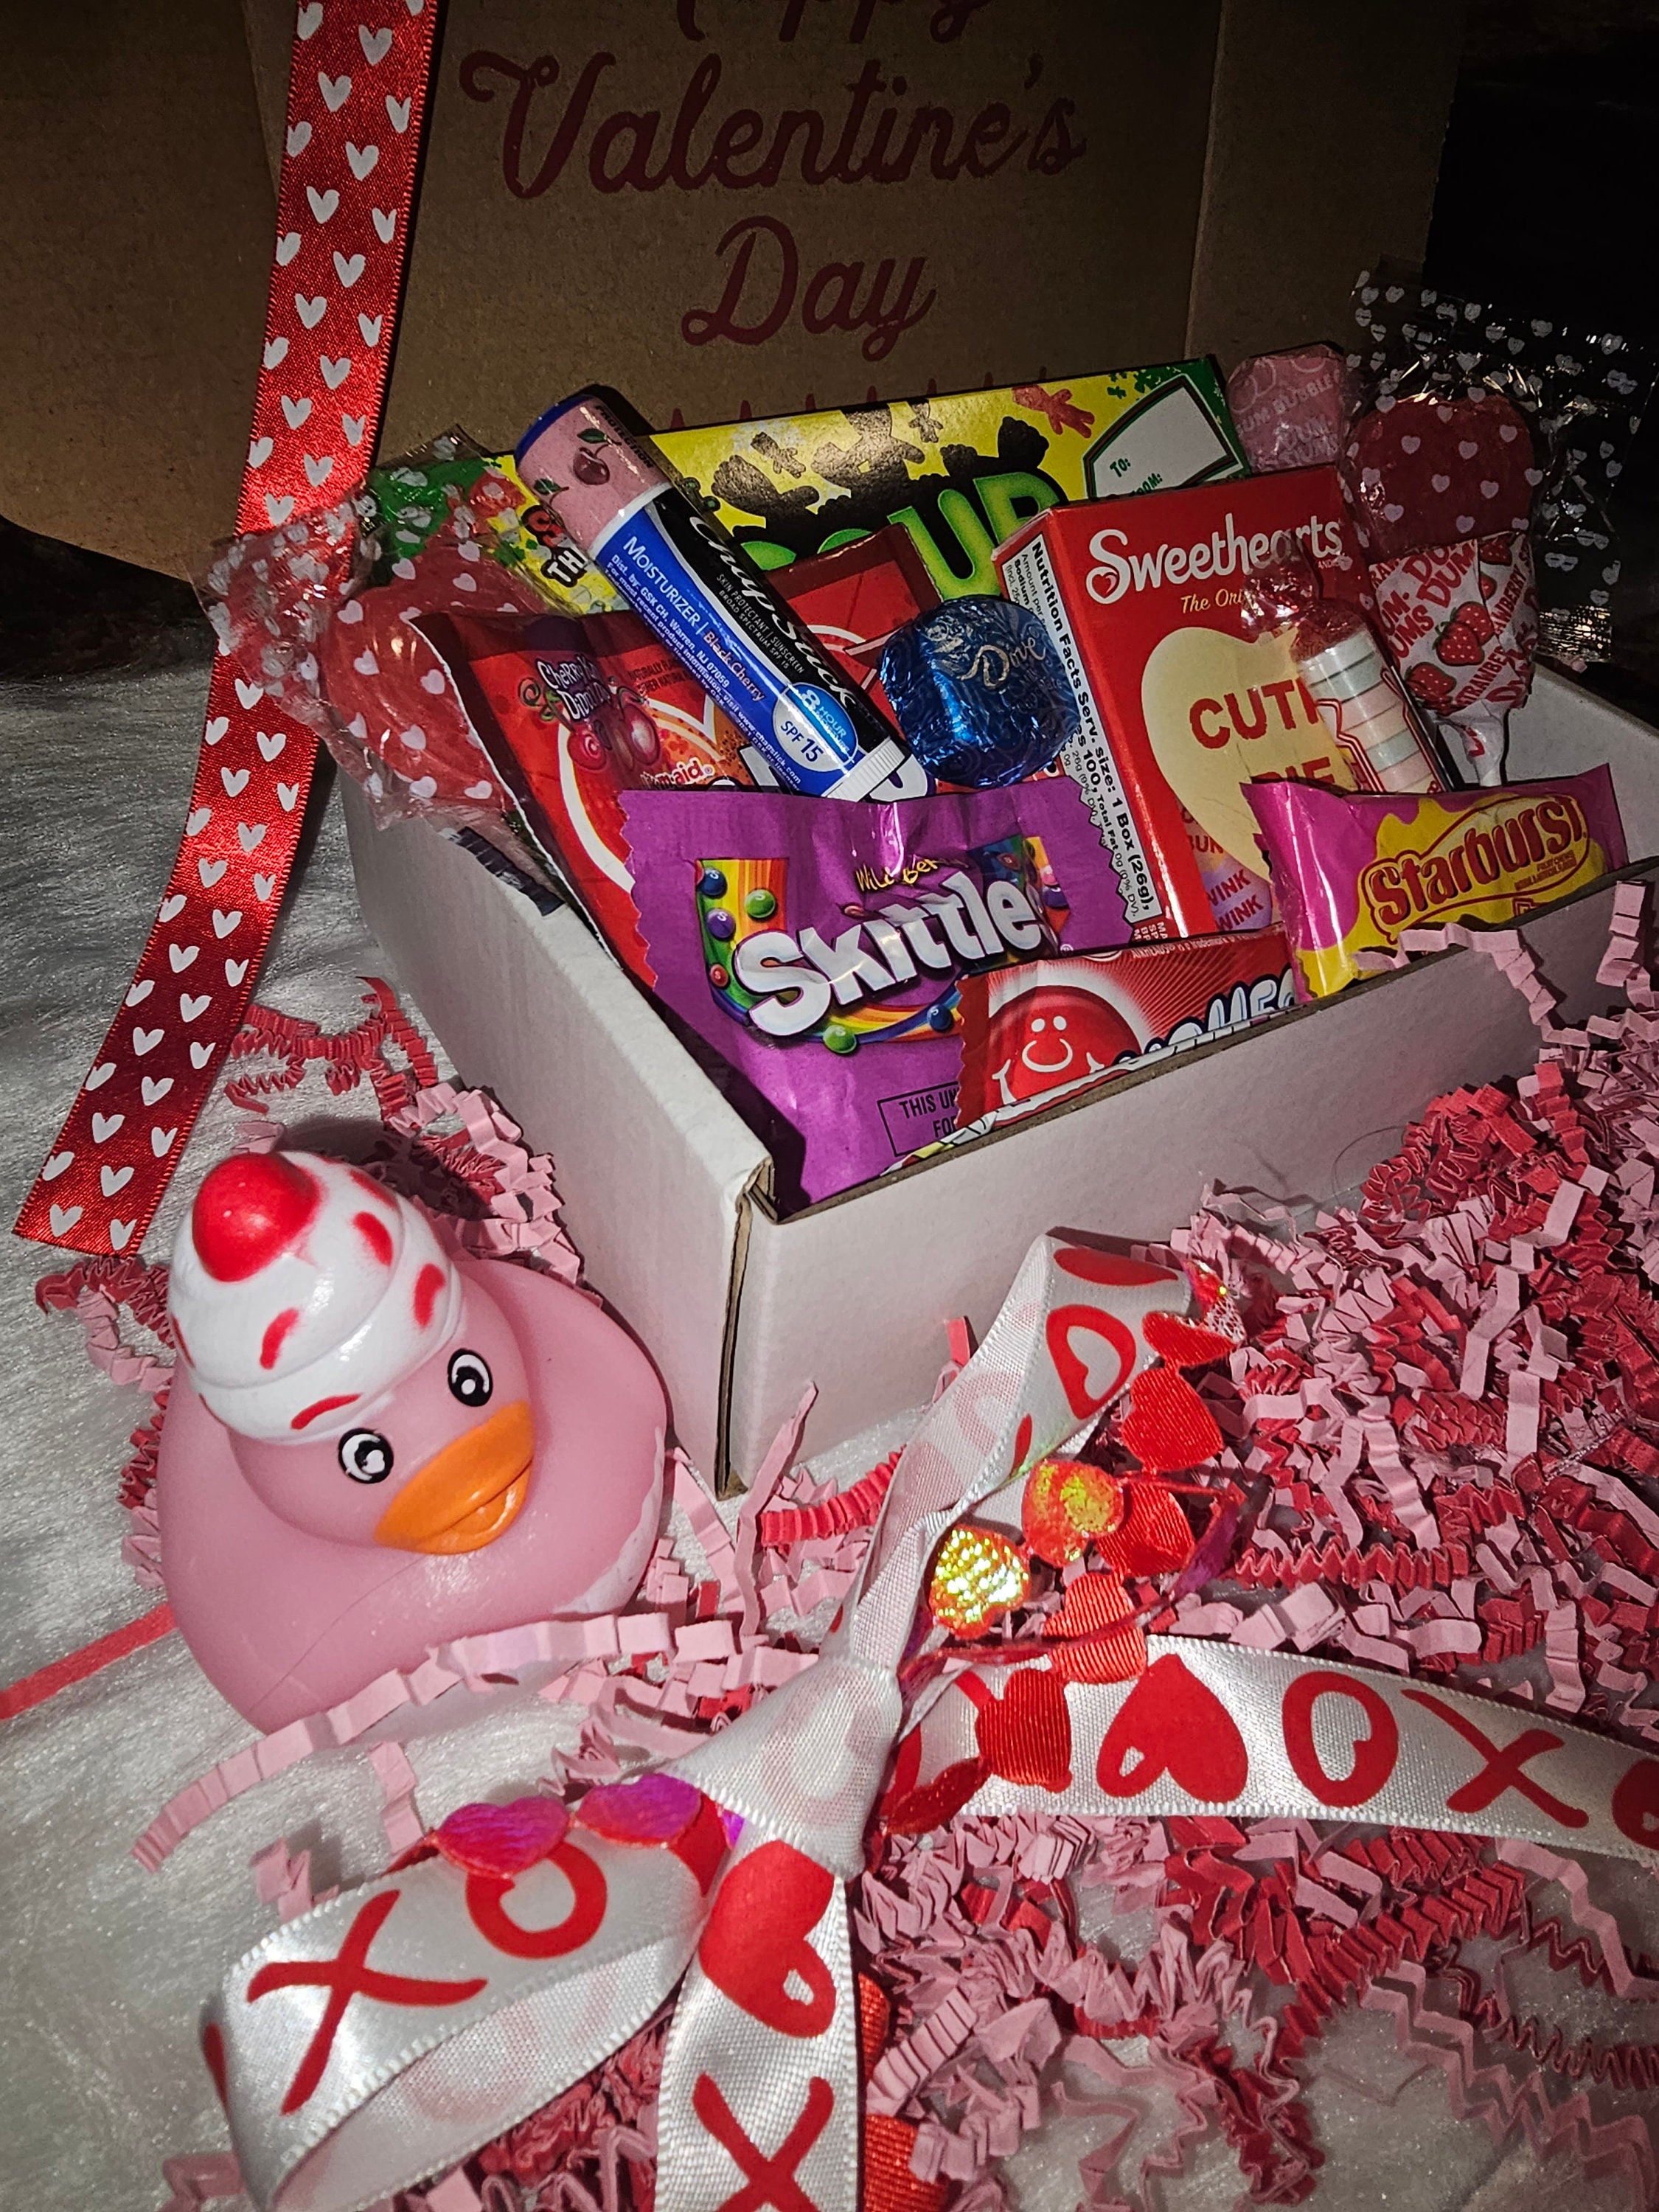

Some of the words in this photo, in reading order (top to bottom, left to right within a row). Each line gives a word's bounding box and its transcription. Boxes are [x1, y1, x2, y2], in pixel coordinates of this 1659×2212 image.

[459, 49, 1088, 199] Valentine's
[681, 215, 937, 363] Day
[1110, 457, 1132, 478] TO:
[1014, 558, 1031, 605] Sodium
[1021, 553, 1038, 596] Amount
[1032, 597, 1044, 616] per
[1032, 540, 1063, 632] Nutrition
[1086, 512, 1343, 605] Sweethearts
[623, 536, 700, 627] MOISTURIZER
[703, 630, 733, 664] Black
[730, 661, 766, 702] Cherry
[689, 516, 857, 709] ChapStick
[716, 573, 734, 592] SKIN
[731, 590, 769, 633] PROTECTANT
[770, 636, 804, 675] SUNSCREEN
[718, 590, 740, 613] BROAD
[738, 613, 770, 648] SPECTRUM
[768, 647, 781, 661] SPF
[1180, 594, 1211, 613] The
[639, 587, 657, 606] GSK
[696, 651, 709, 664] NJ
[706, 662, 729, 688] 07059
[956, 636, 1046, 690] Dove
[1060, 633, 1082, 689] Facts
[606, 562, 620, 577] For
[618, 576, 637, 597] most
[636, 596, 659, 622] recent
[655, 620, 684, 651] product
[723, 694, 739, 712] visit
[737, 709, 801, 785] www.chapstick.com
[781, 720, 804, 743] SPF
[800, 738, 824, 762] 15
[799, 688, 821, 712] 8
[818, 706, 846, 737] HOUR
[1077, 691, 1099, 743] Serv.
[1189, 678, 1319, 750] CUTI
[1096, 746, 1116, 793] size:
[1083, 749, 1102, 794] 100,
[1096, 793, 1113, 827] Total
[1107, 829, 1119, 851] Fat
[1115, 852, 1124, 869] 0g
[1127, 893, 1139, 917] DV).
[1112, 797, 1124, 808] 1
[1116, 812, 1135, 851] Box
[1127, 854, 1155, 911] (26g),
[1368, 795, 1584, 925] Starburst
[899, 1094, 936, 1119] THIS
[939, 1087, 960, 1110] UN
